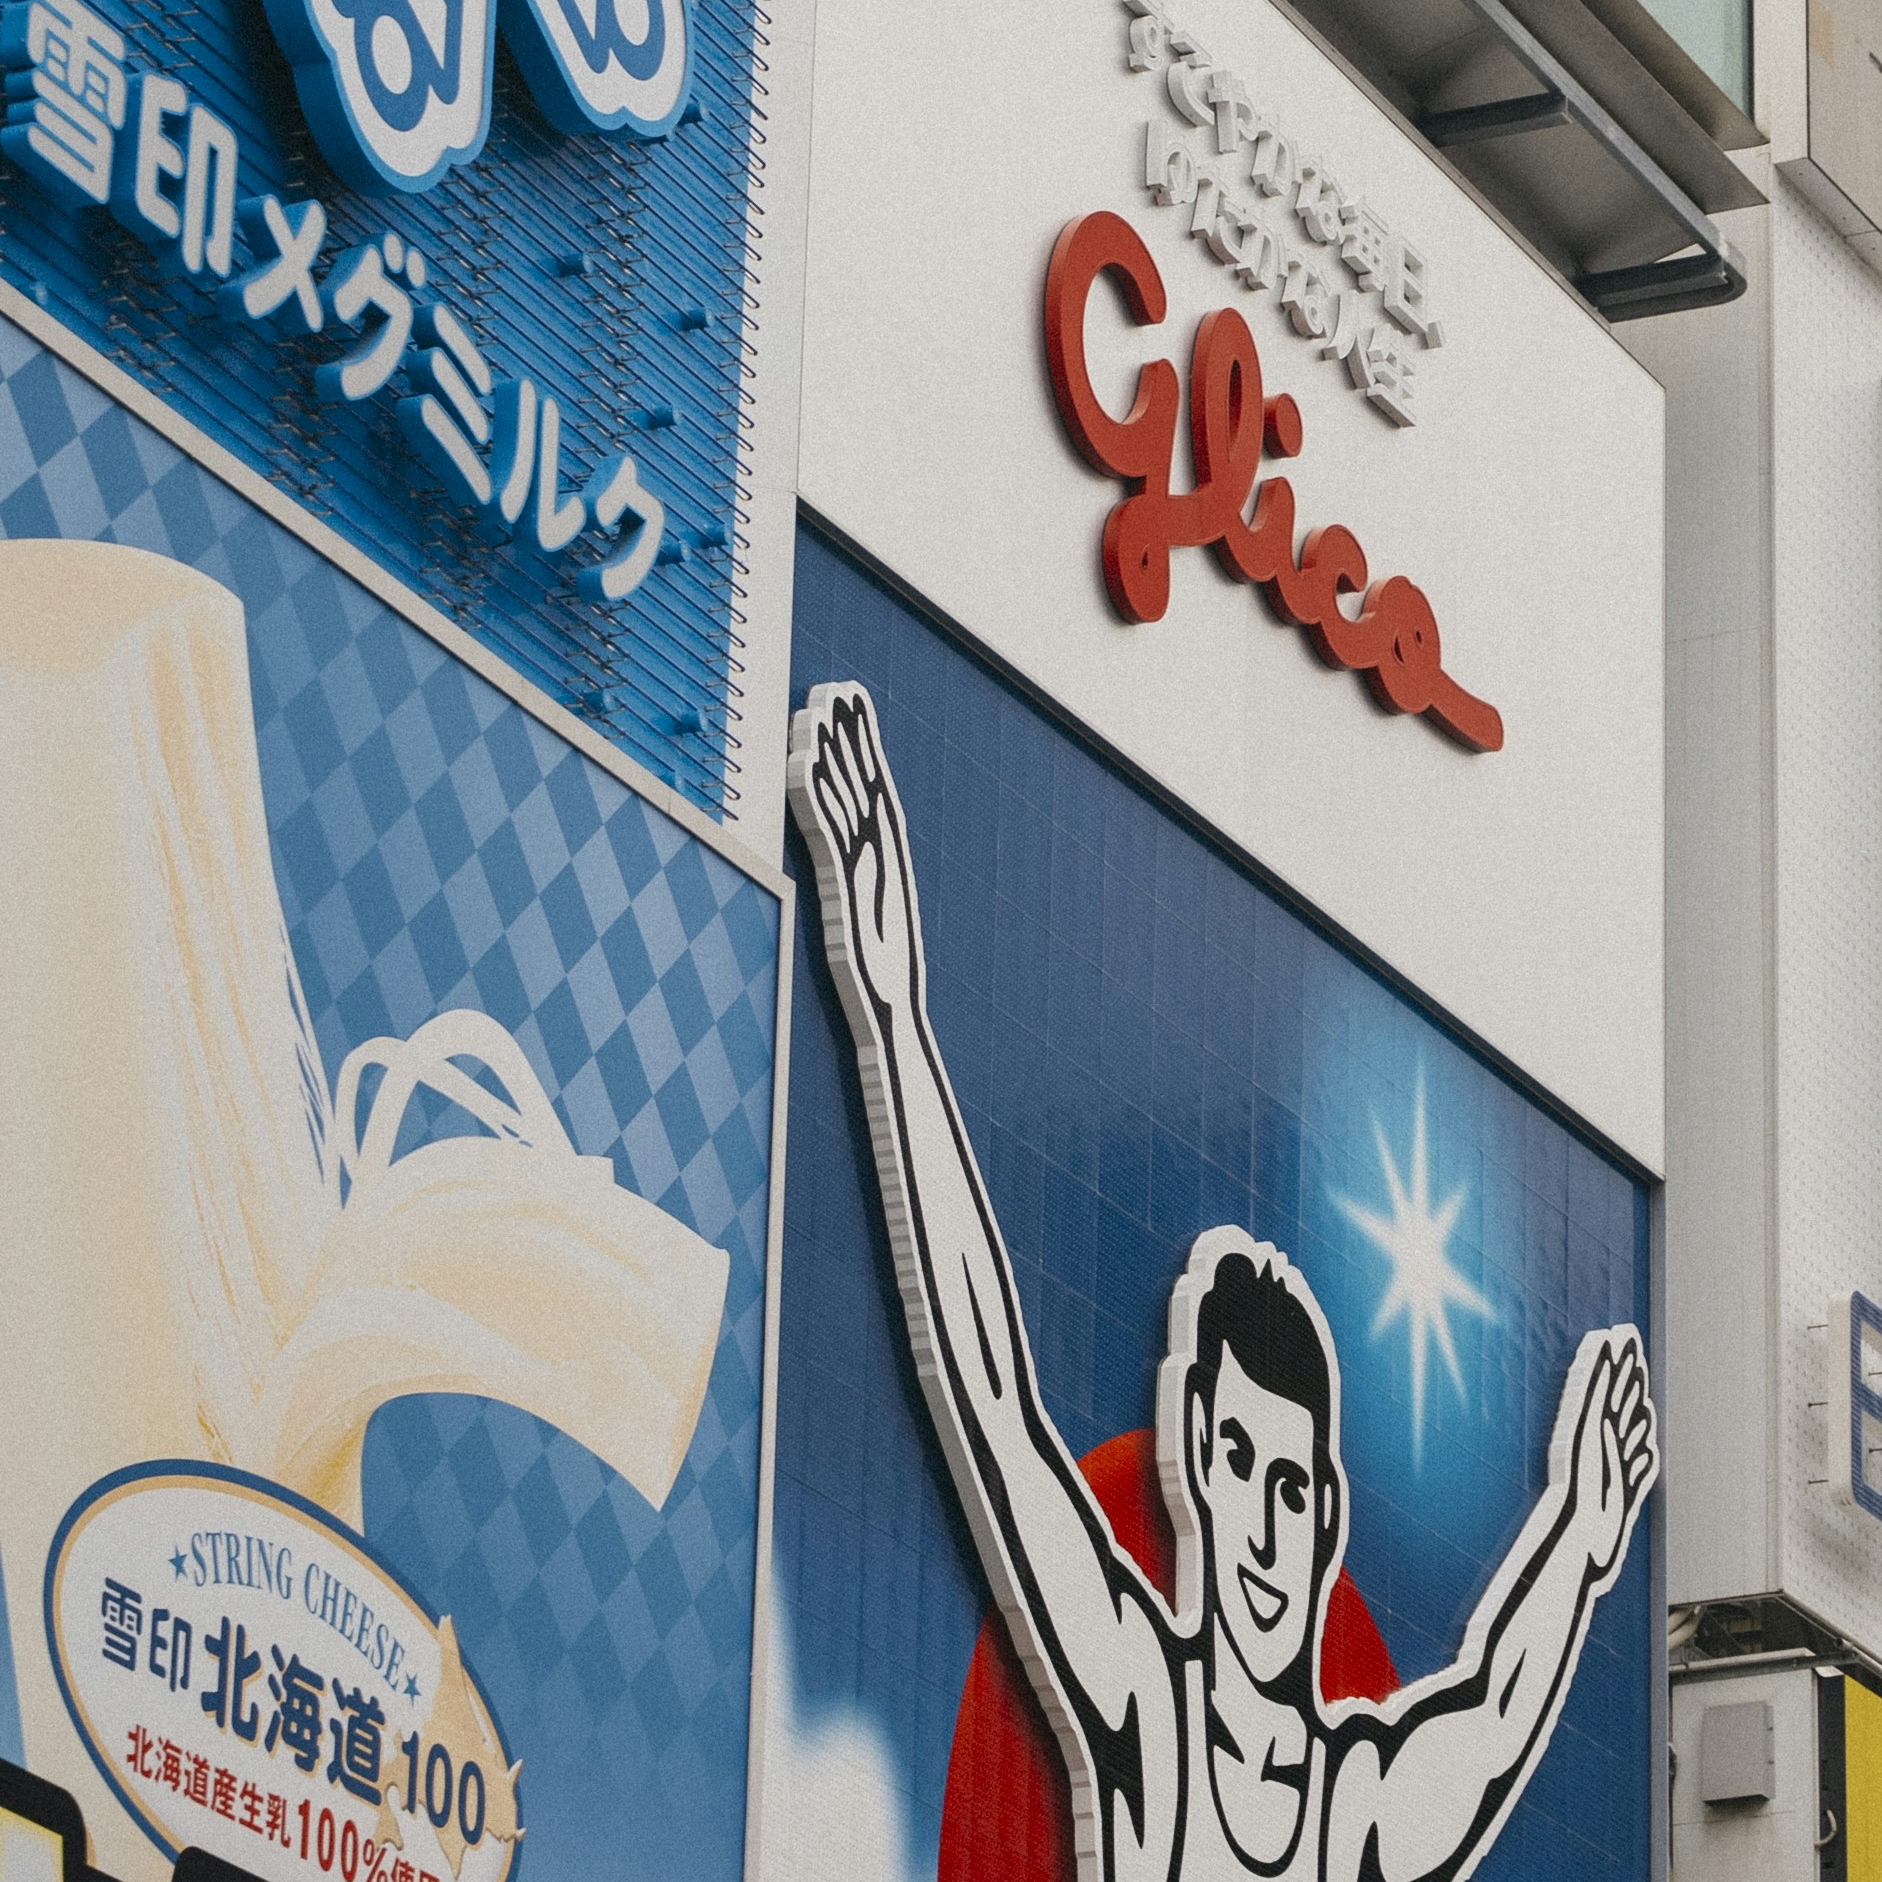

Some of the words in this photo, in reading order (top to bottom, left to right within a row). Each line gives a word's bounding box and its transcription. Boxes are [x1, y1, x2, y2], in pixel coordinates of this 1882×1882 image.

[1146, 120, 1418, 429] ゆたかな人生
[1044, 210, 1505, 754] Glico
[189, 1529, 294, 1603] STRING
[303, 1562, 406, 1693] CHEESE
